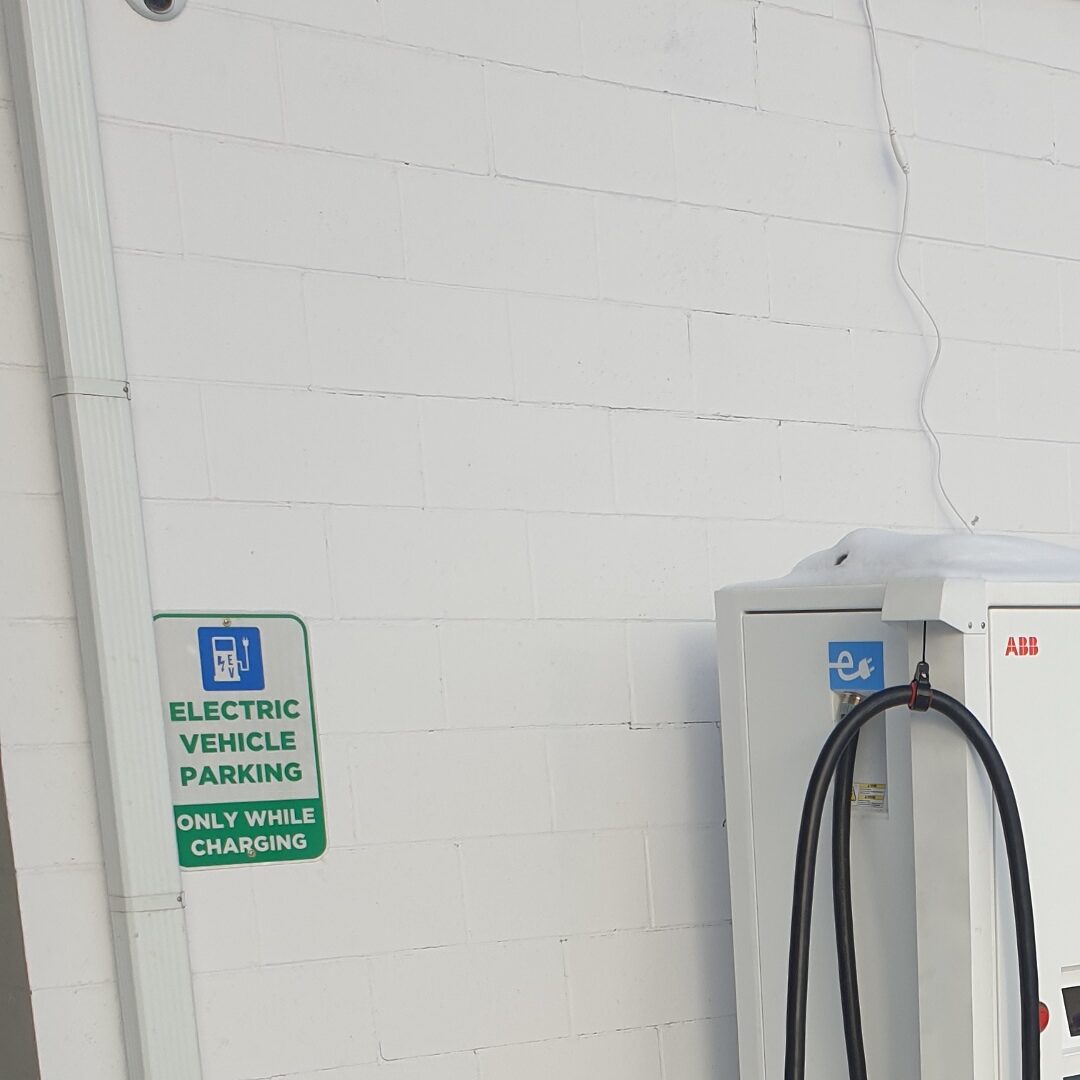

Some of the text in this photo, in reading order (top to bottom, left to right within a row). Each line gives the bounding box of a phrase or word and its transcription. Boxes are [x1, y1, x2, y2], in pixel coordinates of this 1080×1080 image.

[1005, 636, 1039, 656] ABB
[169, 699, 300, 721] ELECTRIC
[179, 731, 297, 753] VEHICLE
[180, 762, 302, 786] PARKING
[177, 808, 316, 831] ONLY WHILE
[191, 833, 307, 856] CHARGING
